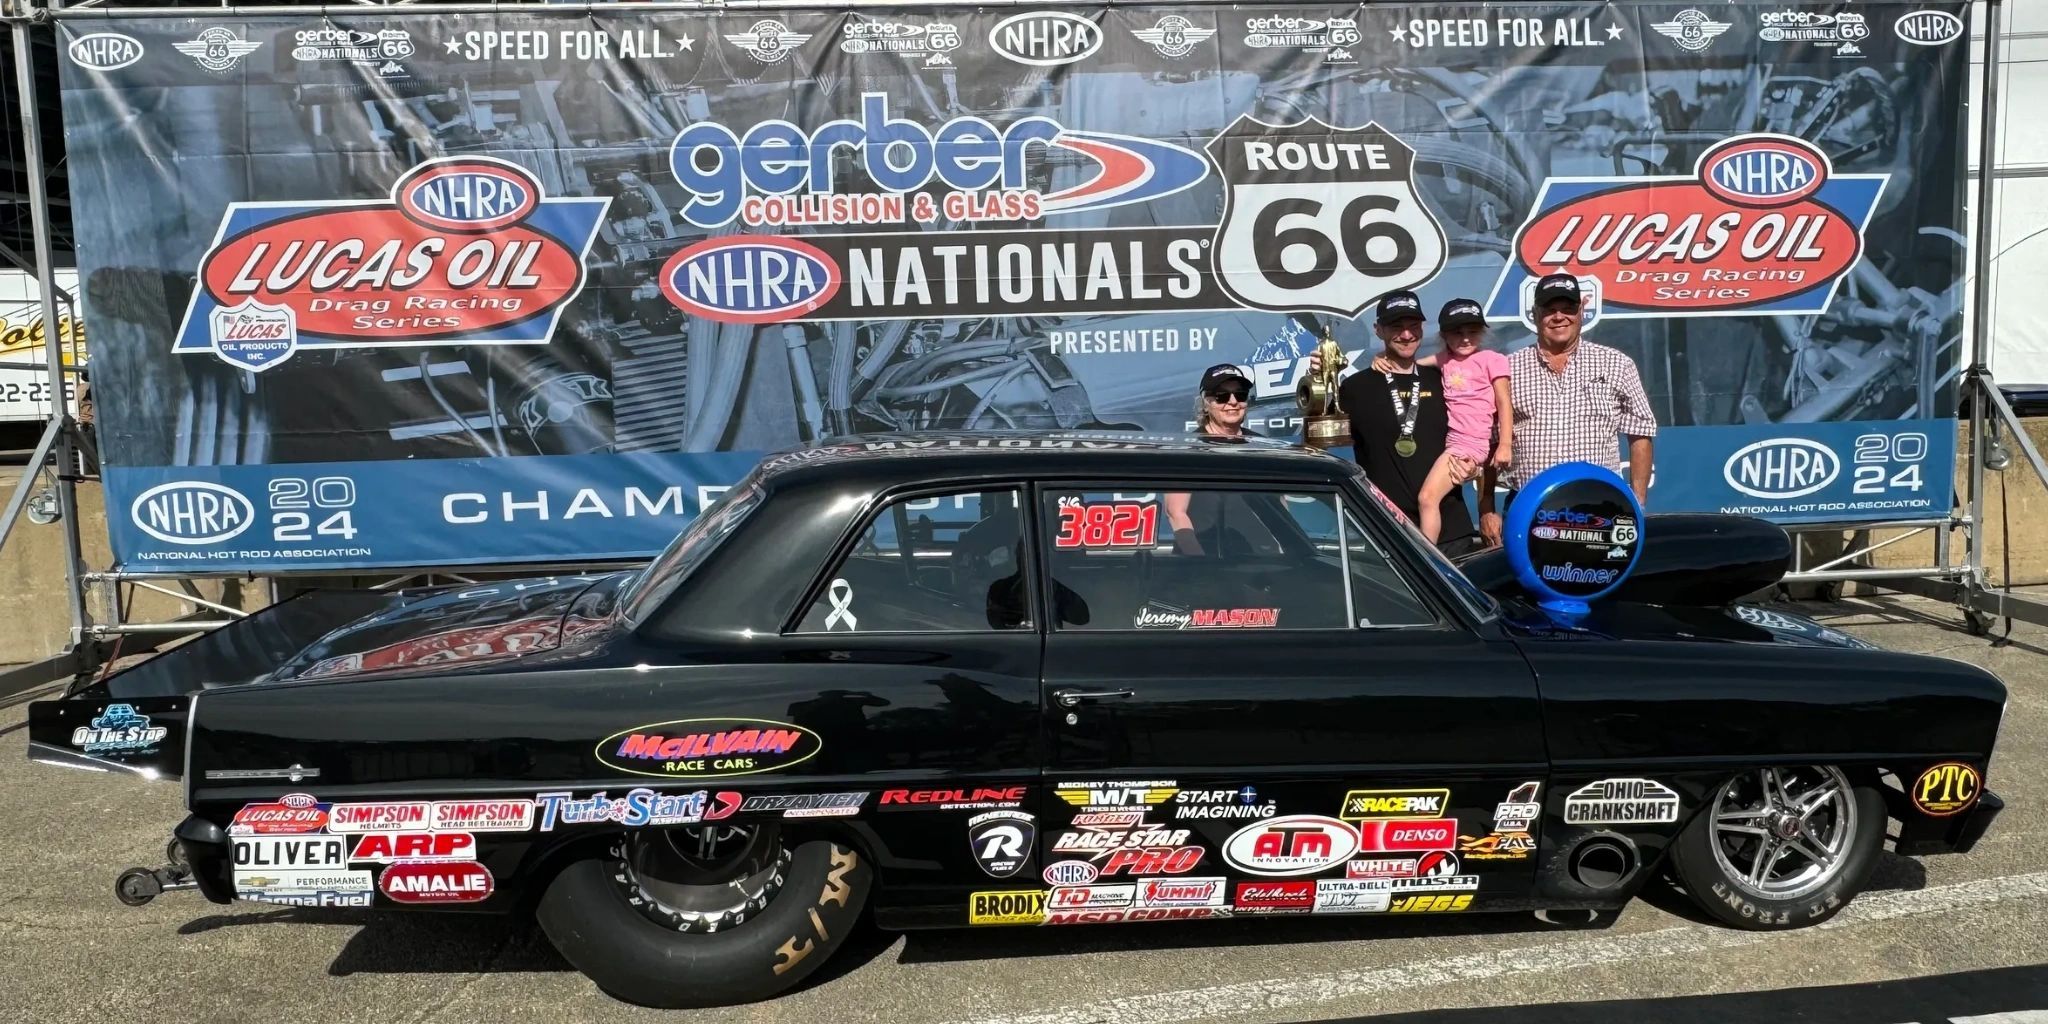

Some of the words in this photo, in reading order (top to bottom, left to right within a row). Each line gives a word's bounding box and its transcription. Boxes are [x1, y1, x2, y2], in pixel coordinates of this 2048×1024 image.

[1246, 14, 1304, 32] gerber
[1760, 9, 1815, 26] gerber
[843, 18, 902, 38] gerber
[1409, 19, 1488, 47] SPEED
[1498, 18, 1545, 46] FOR
[1684, 27, 1700, 37] 66
[1785, 28, 1835, 39] NATIONALS
[1841, 24, 1866, 38] 66
[1903, 14, 1955, 39] NHRA
[295, 26, 354, 45] gerber
[760, 38, 777, 49] 66
[931, 34, 957, 48] 66
[1005, 19, 1090, 57] NHRA
[1166, 33, 1182, 44] 66
[1272, 34, 1326, 45] NATIONALS
[1332, 30, 1358, 43] 66
[78, 38, 134, 65] NHRA
[209, 46, 226, 57] 66
[383, 41, 410, 56] 66
[465, 30, 549, 61] SPEED
[560, 30, 611, 60] FOR
[869, 39, 924, 50] NATIONALS
[322, 48, 377, 59] NATIONALS
[669, 92, 1064, 229] gerber
[1244, 141, 1391, 170] ROUTE
[1723, 150, 1806, 195] NHRA
[424, 174, 516, 220] NHRA
[742, 192, 903, 226] COLLISION
[912, 193, 940, 223] &
[943, 191, 1041, 221] GLASS
[1252, 194, 1417, 290] 66
[1538, 212, 1742, 266] LUCAS
[1741, 212, 1828, 263] OIL
[227, 237, 443, 295] LUCAS
[446, 238, 543, 292] OIL
[688, 248, 816, 309] NHRA
[848, 239, 1201, 307] NATIONALS
[1615, 270, 1690, 284] Drag
[1702, 267, 1805, 283] Racing
[1653, 285, 1750, 300] Series
[309, 297, 391, 315] Drag
[404, 294, 521, 313] Racing
[352, 314, 461, 329] Series
[225, 323, 286, 339] LUCAS
[221, 343, 237, 351] OIL
[240, 342, 288, 351] PRODUCTS
[1050, 328, 1179, 354] PRESENTED
[1189, 328, 1219, 350] BY
[1853, 432, 1928, 463] 20
[1741, 447, 1826, 489] NHRA
[1852, 464, 1923, 494] 24
[268, 476, 356, 509] 20
[1058, 496, 1080, 507] S/G
[1720, 505, 1786, 514] NATIONAL
[1789, 504, 1815, 512] HOT
[1848, 499, 1931, 510] ASSOCIATION
[149, 492, 239, 535] NHRA
[1537, 507, 1595, 524] gerber
[272, 511, 358, 541] 24
[1056, 504, 1157, 547] 3821
[1616, 527, 1635, 541] 66
[1559, 530, 1604, 542] NATIONAL
[138, 551, 206, 560] NATIONAL
[208, 551, 237, 559] HOT
[240, 550, 271, 558] ROD
[273, 548, 371, 558] ASSOCIATION
[1542, 562, 1618, 583] winner
[1136, 608, 1191, 630] Jeremy
[1191, 609, 1280, 627] MASON
[100, 727, 125, 742] THE
[126, 726, 166, 742] STOP
[666, 760, 705, 771] RACE
[714, 758, 753, 769] CARS
[1058, 781, 1105, 789] MICKEY
[1106, 780, 1177, 788] THOMPSON
[1604, 781, 1644, 800] OHIO
[1919, 765, 1974, 801] PTC
[880, 787, 1027, 804] REDLINE
[1090, 788, 1151, 806] M/T
[1175, 790, 1238, 803] START
[437, 803, 525, 821] SIMPSON
[1176, 804, 1276, 819] IMAGINING
[1362, 796, 1440, 813] RACEPAK
[1496, 805, 1539, 819] PRO
[1567, 802, 1676, 820] CRANKSHAFT
[240, 809, 296, 822] LUCAS
[294, 809, 320, 822] OIL
[335, 804, 424, 823] SIMPSON
[468, 820, 523, 828] RESTRAINTS
[975, 825, 1024, 859] R
[1054, 831, 1124, 848] RACE
[1124, 829, 1190, 847] STAR
[1392, 829, 1448, 842] DENSO
[234, 841, 341, 865] OLIVER
[353, 834, 473, 857] ARP
[1100, 846, 1205, 875] PRO
[1350, 860, 1414, 872] WHITE
[296, 877, 368, 886] PERFORMANCE
[1052, 865, 1092, 883] NHRA
[1392, 877, 1477, 887] MOSER
[388, 875, 487, 892] AMALIE
[1319, 881, 1388, 891] ULTRA-BELL
[1242, 888, 1307, 902] Edelbrock
[1390, 895, 1474, 912] JEGS
[773, 841, 858, 976] M/T
[975, 894, 1048, 915] BRODIX
[1052, 912, 1124, 924] MSD
[1128, 908, 1213, 920] COMP
